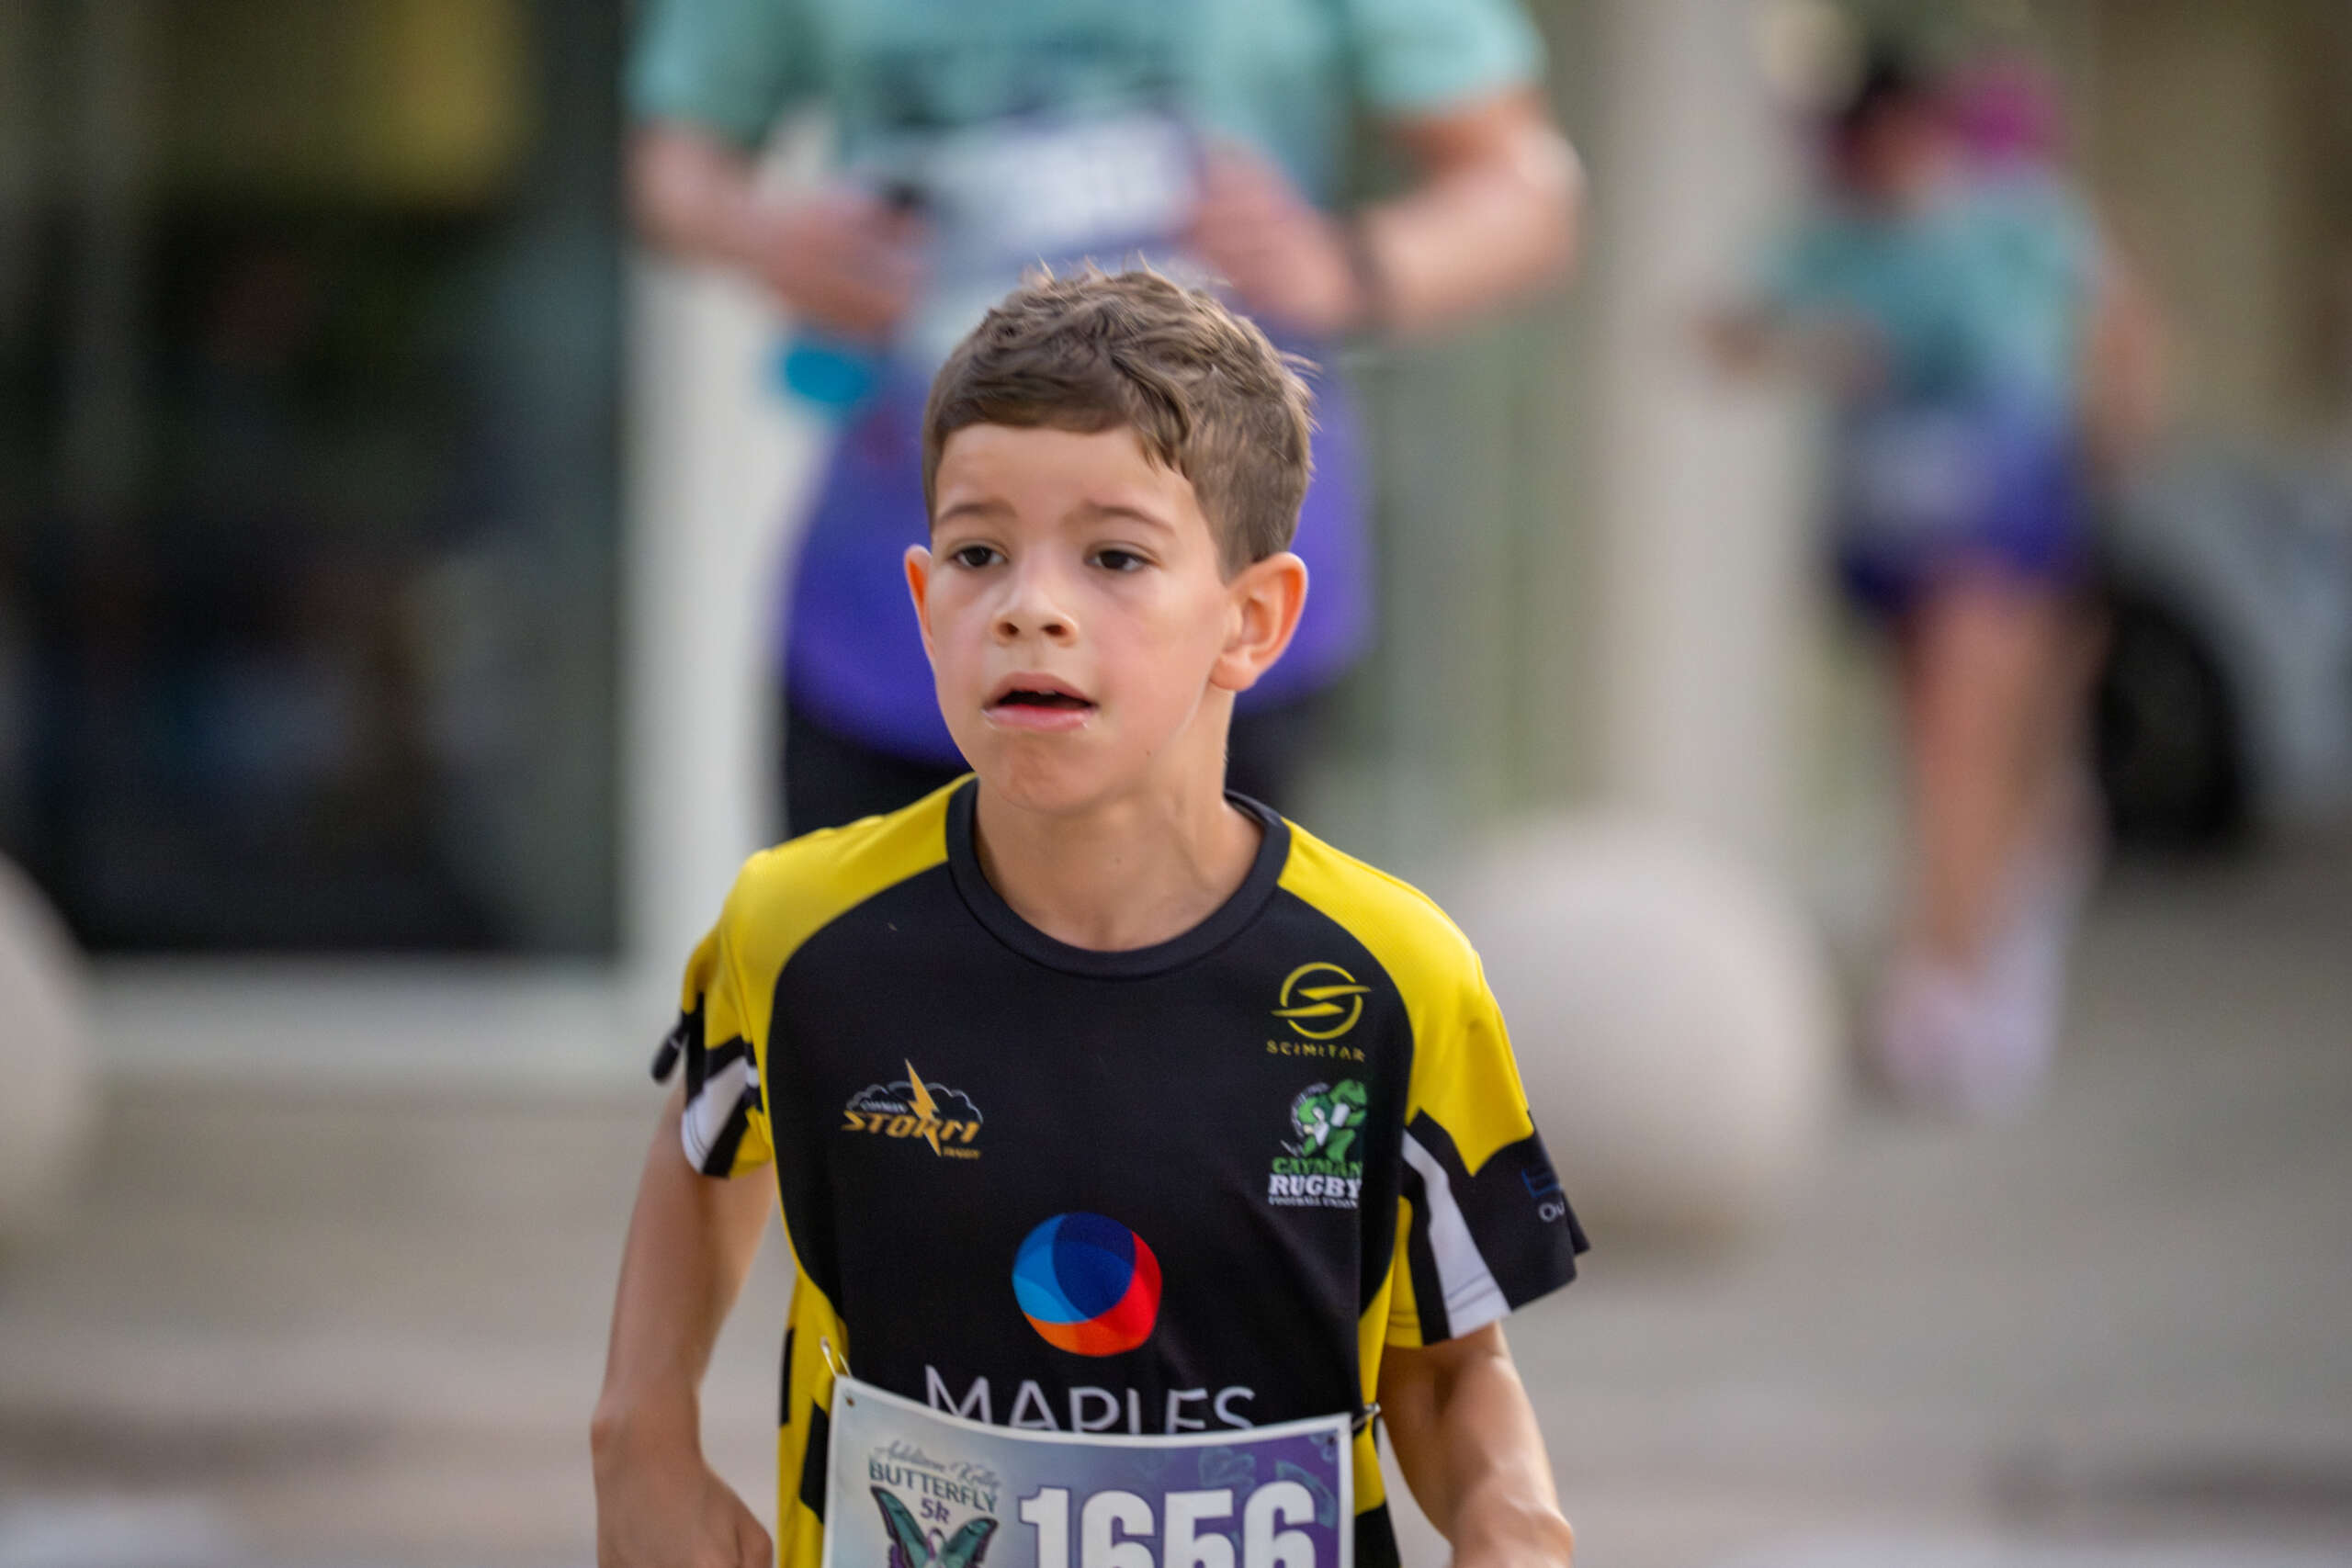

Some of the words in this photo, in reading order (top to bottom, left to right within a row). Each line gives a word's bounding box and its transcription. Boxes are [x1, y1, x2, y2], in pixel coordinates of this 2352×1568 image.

[1266, 1039, 1366, 1063] SCIMITAR
[841, 1110, 980, 1144] STORM
[1268, 1174, 1362, 1199] RUGBY
[869, 1457, 998, 1514] BUTTERFLY
[1019, 1481, 1317, 1568] 1656
